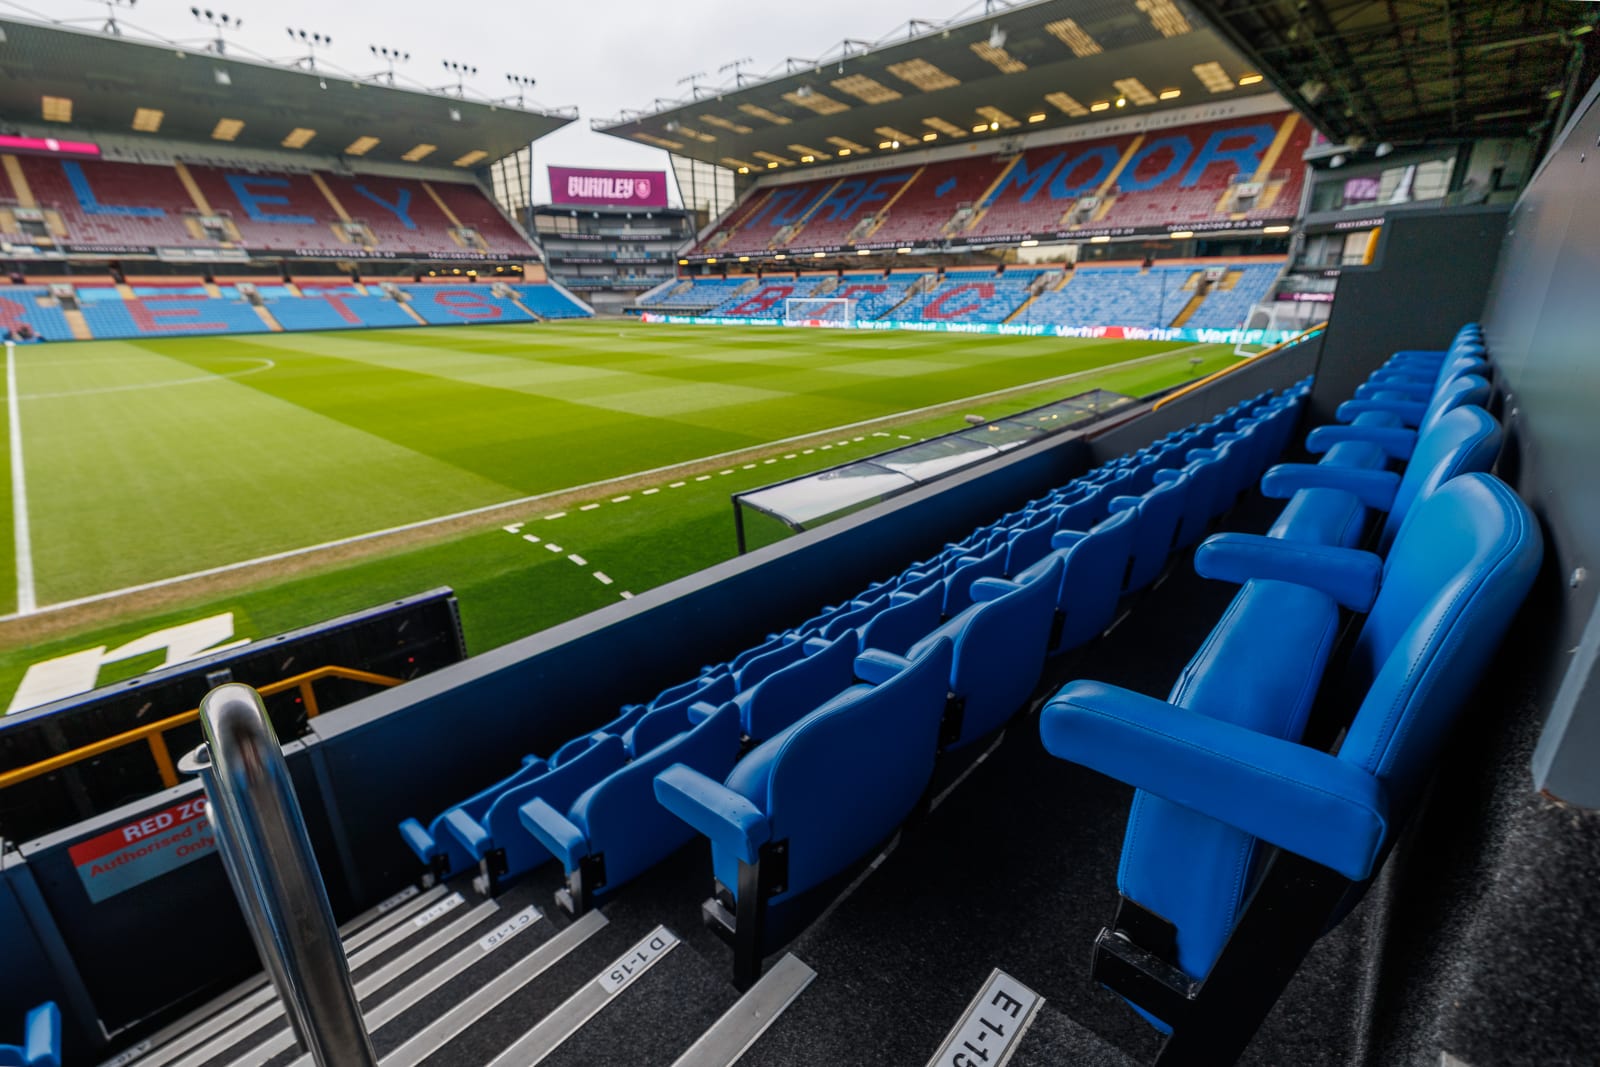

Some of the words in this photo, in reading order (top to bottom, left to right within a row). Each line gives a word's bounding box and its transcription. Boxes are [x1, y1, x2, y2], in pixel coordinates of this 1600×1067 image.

[567, 176, 634, 199] BURNLEY
[746, 173, 912, 229] TURF
[983, 124, 1276, 206] MOOR
[1055, 325, 1107, 338] Vertu
[1123, 327, 1182, 341] Vertu
[122, 814, 173, 842] RED
[177, 799, 208, 820] ZO
[90, 826, 193, 878] Authorised
[519, 914, 530, 924] C
[488, 924, 517, 945] 1-15
[649, 936, 667, 953] D
[609, 951, 650, 984] 1-15
[991, 990, 1024, 1018] E
[952, 1017, 1005, 1067] 1-15
